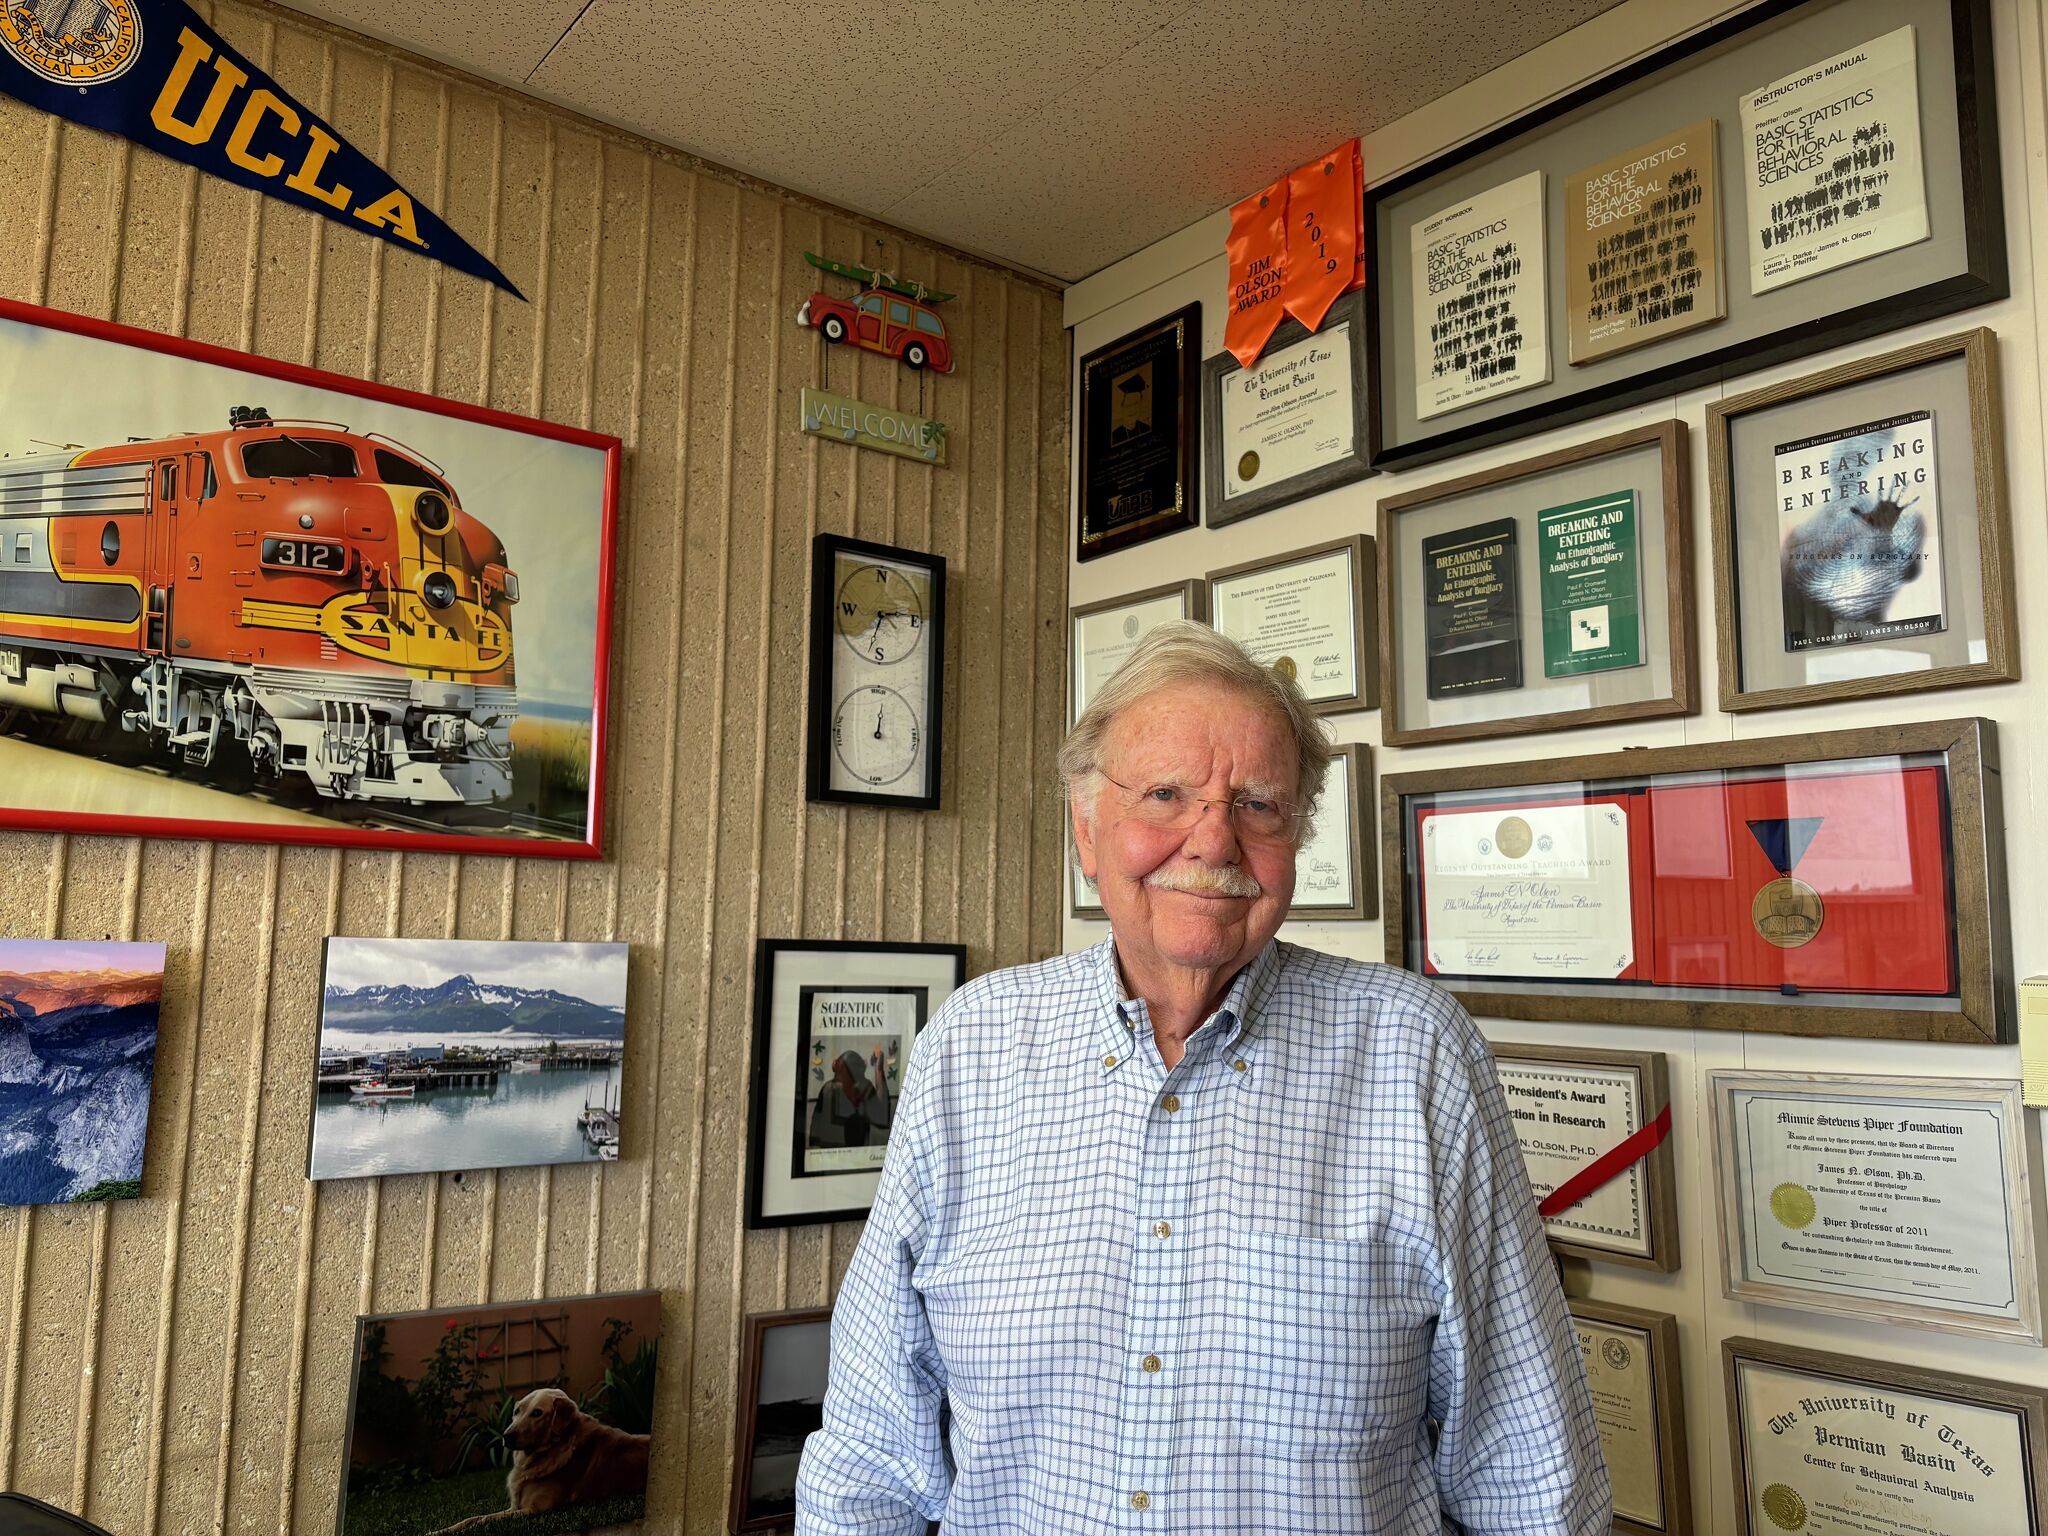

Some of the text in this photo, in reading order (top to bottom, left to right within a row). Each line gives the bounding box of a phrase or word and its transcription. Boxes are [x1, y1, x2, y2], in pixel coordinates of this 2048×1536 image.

[23, 45, 61, 73] UCLA
[72, 40, 96, 56] LIGHT
[1754, 71, 1823, 107] INSTRUCTOR'S
[1825, 53, 1868, 76] MANUAL
[1756, 89, 1874, 147] BASIC STATISTICS
[150, 25, 425, 247] UCLA
[1757, 126, 1815, 160] FOR THE
[1758, 130, 1847, 174] BEHAVIORAL
[1586, 143, 1686, 193] BASIC STATISTICS
[1759, 152, 1824, 187] SCIENCES
[1587, 176, 1635, 206] FOR THE
[1587, 180, 1662, 218] BEHAVIORAL
[1424, 219, 1443, 233] STUDENT
[1445, 207, 1472, 222] WORKBOOK
[1587, 200, 1641, 231] SCIENCES
[1427, 242, 1453, 262] BASIC
[1455, 219, 1507, 249] STATISTICS
[1763, 261, 1782, 270] Laura
[1793, 250, 1812, 261] Darke
[1817, 241, 1840, 252] James
[1851, 229, 1872, 240] Olson
[1248, 256, 1270, 279] JIM
[1428, 247, 1466, 273] FOR THE
[1429, 251, 1488, 285] BEHAVIORAL
[1764, 264, 1791, 277] Kenneth
[1236, 267, 1281, 299] OLSON
[1429, 269, 1472, 296] SCIENCES
[1234, 284, 1281, 315] AWARD
[1244, 350, 1331, 393] The University of Texas
[1260, 372, 1315, 400] Permian Basin
[1299, 388, 1318, 401] Award
[813, 400, 931, 448] WELCOME
[1782, 438, 1925, 485] BREAKING
[1841, 471, 1862, 480] AND
[1784, 468, 1927, 512] ENTERING
[1548, 510, 1624, 537] BREAKING AND
[1556, 541, 1616, 561] An Ethnographic
[1560, 527, 1611, 548] ENTERING
[278, 541, 329, 569] 312
[1436, 544, 1503, 569] BREAKING AND
[1549, 552, 1624, 573] Analysis of Burglary
[876, 571, 887, 583] N
[1444, 573, 1497, 591] An Ethnographic
[1447, 560, 1492, 579] ENTERING
[1438, 583, 1504, 602] Analysis of Burglary
[841, 602, 919, 628] W E
[341, 614, 501, 647] SANTA FE
[1794, 638, 1812, 647] PAUL
[1817, 632, 1858, 643] CROMWELL
[1865, 627, 1891, 636] JAMES
[1904, 621, 1930, 631] OLSON
[875, 647, 884, 661] S
[820, 1001, 884, 1014] SCIENTIFIC
[819, 1016, 884, 1029] AMERICAN
[1508, 1085, 1605, 1104] President's Award
[1509, 1108, 1605, 1129] ction in Research
[1777, 1112, 1963, 1135] Minnie Stevens Piper Foundation
[1520, 1139, 1568, 1153] N. OLSON,
[1817, 1163, 1845, 1173] James
[1896, 1170, 1925, 1181] Ph.D.
[1823, 1217, 1928, 1236] Piper Professor of 2011
[1582, 1335, 1592, 1344] of
[1767, 1396, 1996, 1477] The University of Texas
[1814, 1426, 1955, 1473] Permian Basin
[1804, 1454, 1975, 1502] Center for Behavioral Analysis
